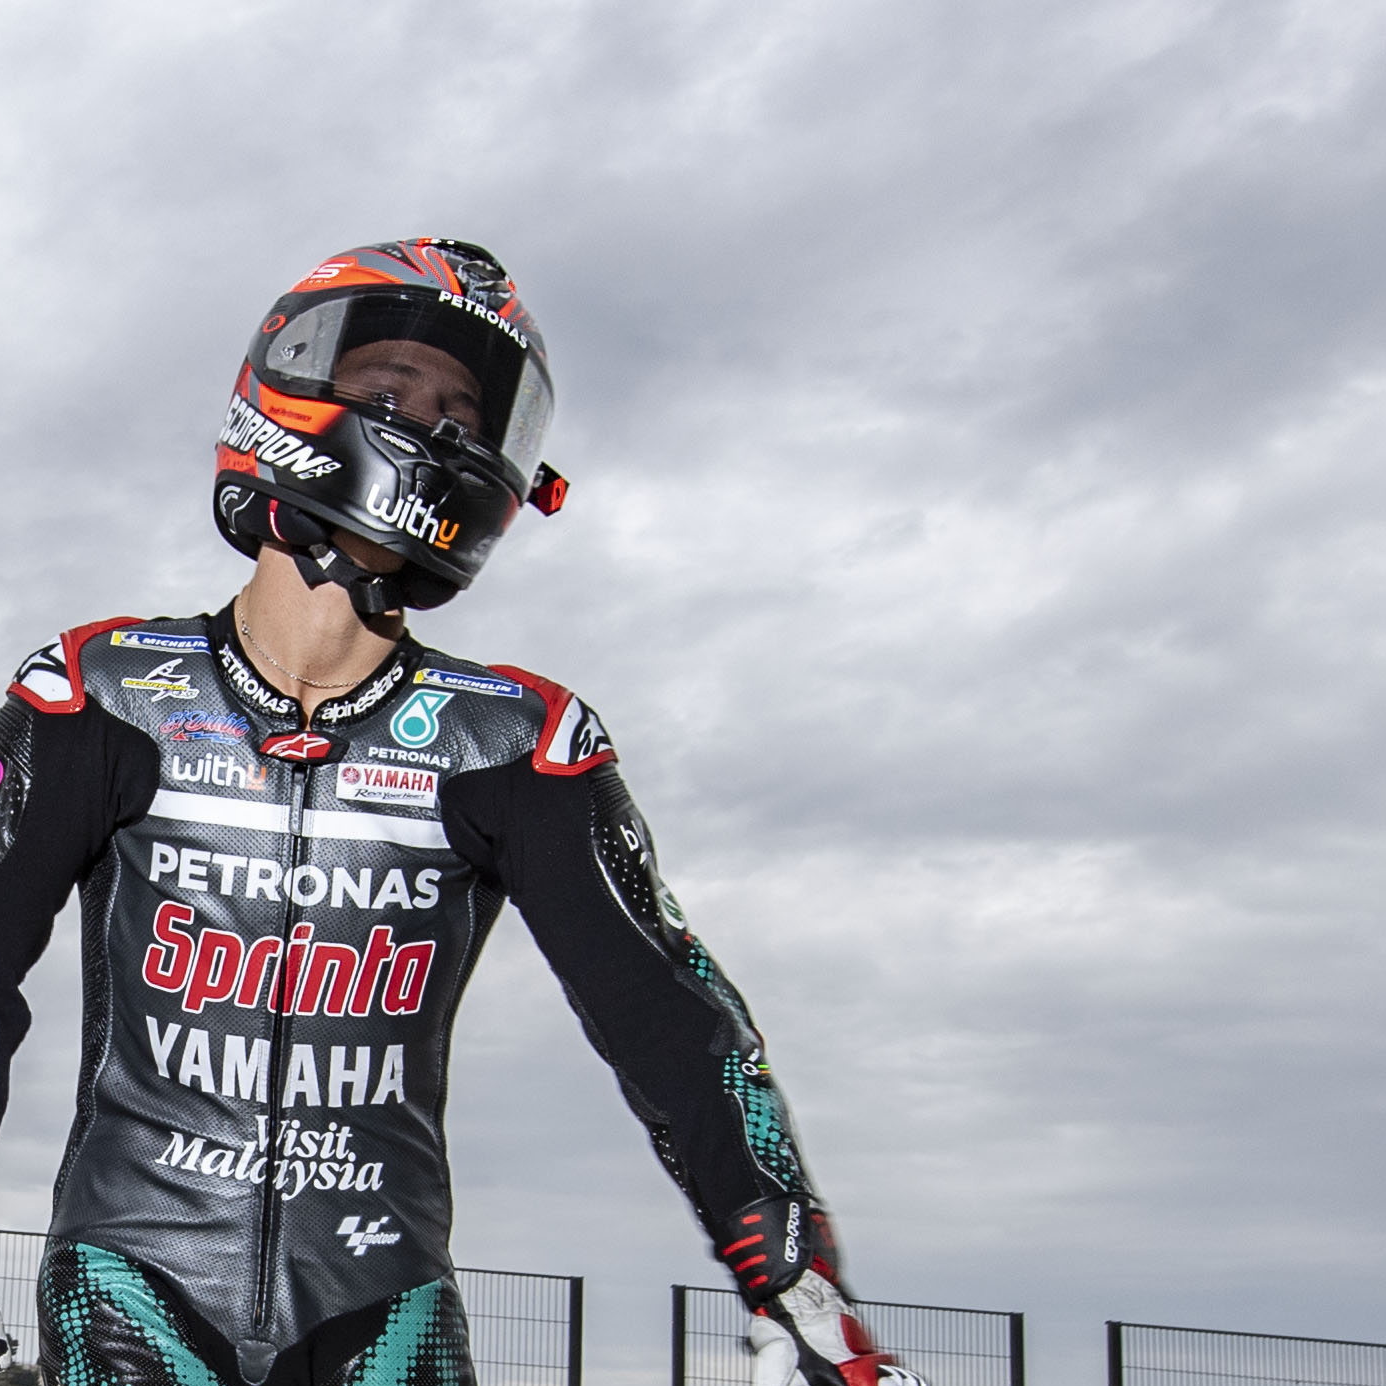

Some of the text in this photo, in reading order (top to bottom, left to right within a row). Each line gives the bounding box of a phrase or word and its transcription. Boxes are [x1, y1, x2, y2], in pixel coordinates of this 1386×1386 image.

[438, 290, 529, 350] PETRONAS
[218, 392, 324, 474] SCORPION
[142, 637, 209, 648] MICHELIN
[321, 659, 404, 723] alpinestars
[444, 676, 512, 692] MICHELIN
[363, 767, 434, 793] YAMAHA
[368, 746, 451, 769] PETRONAS
[147, 841, 443, 910] PETRONAS
[141, 899, 437, 1018] Sprinta
[144, 1014, 408, 1109] YAMAHA
[154, 1130, 384, 1201] Malaysia
[254, 1113, 355, 1160] Visit
